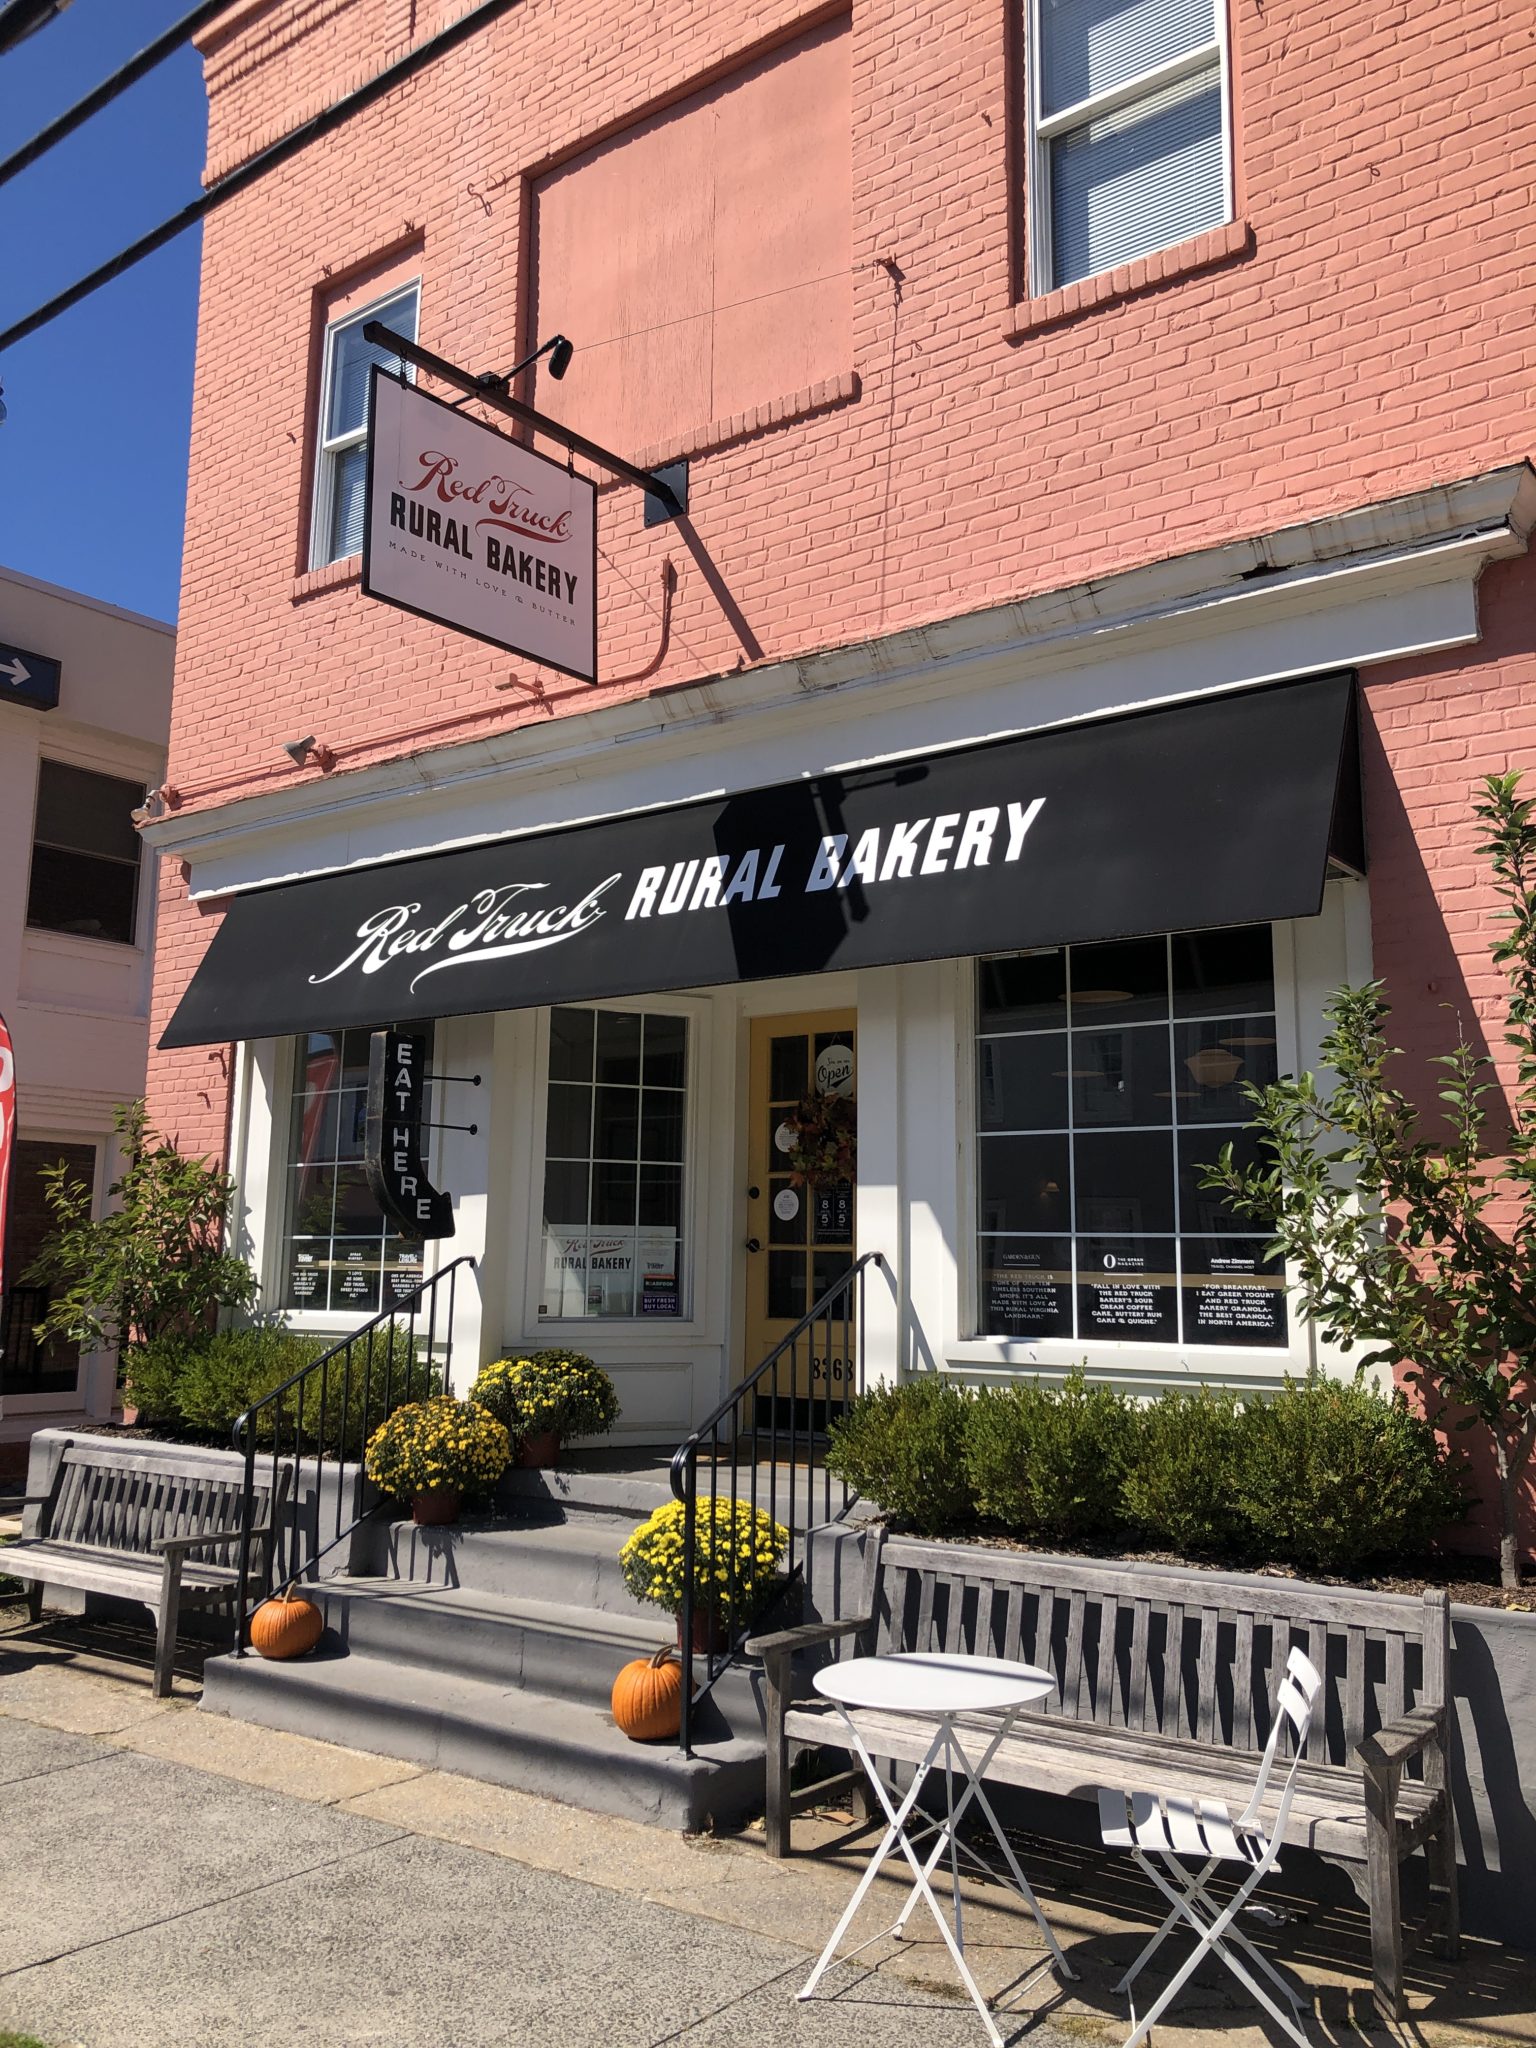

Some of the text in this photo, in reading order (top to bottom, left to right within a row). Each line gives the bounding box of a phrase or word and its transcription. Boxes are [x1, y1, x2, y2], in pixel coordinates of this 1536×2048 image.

[398, 450, 574, 542] Red Truck
[390, 492, 578, 605] RURAL BAKERY
[389, 540, 426, 563] MADE
[435, 561, 468, 580] WITH
[475, 578, 507, 597] LOVE
[532, 602, 576, 627] BUTTER
[308, 797, 1047, 985] Red Truck RURAL BAKERY
[394, 1043, 412, 1112] EAT
[818, 1065, 851, 1088] Open
[393, 1127, 431, 1220] HERE
[822, 1200, 828, 1208] 8
[839, 1200, 846, 1208] 8
[822, 1214, 828, 1223] 5
[838, 1214, 846, 1223] 5
[554, 1257, 632, 1269] RURAL BAKERY
[1103, 1254, 1116, 1268] O
